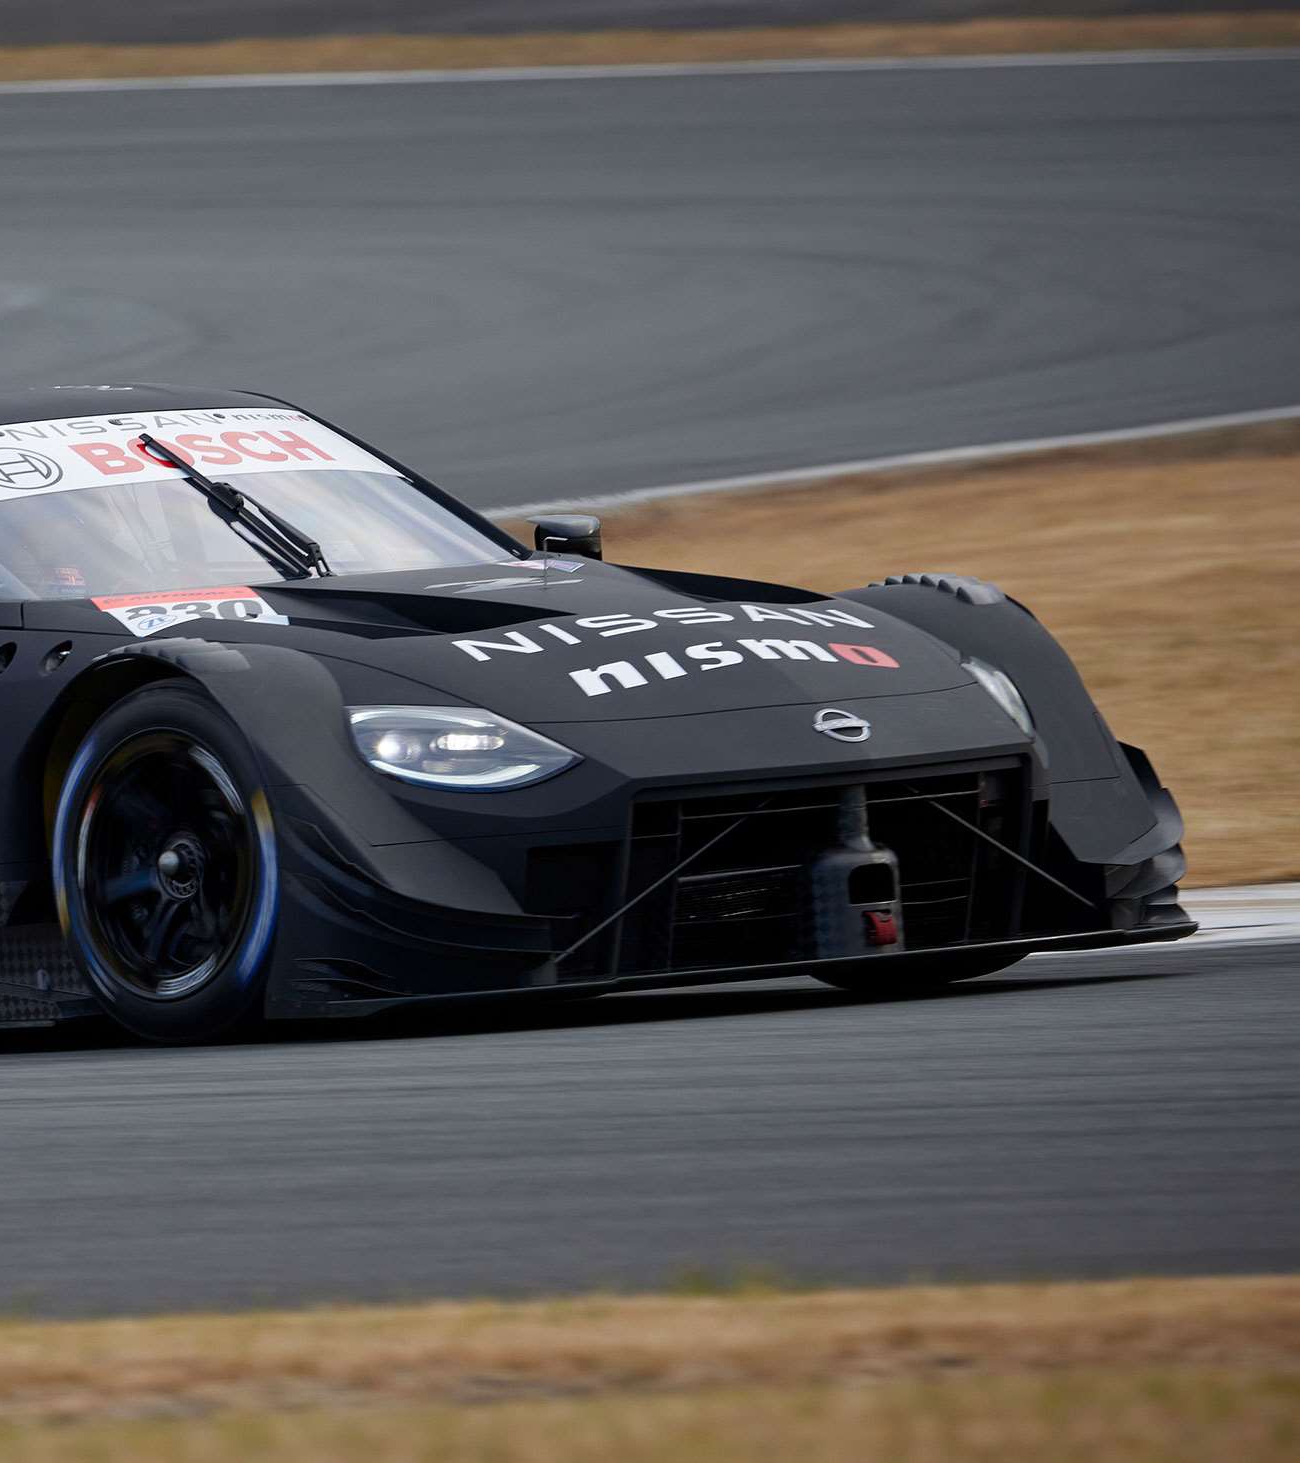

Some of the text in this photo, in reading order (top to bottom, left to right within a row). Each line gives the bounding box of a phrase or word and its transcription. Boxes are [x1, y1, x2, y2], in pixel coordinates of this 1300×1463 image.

[5, 412, 223, 441] NISSAN
[68, 430, 338, 476] BOSCH
[451, 604, 875, 662] NISSAN
[568, 638, 900, 697] nismo
